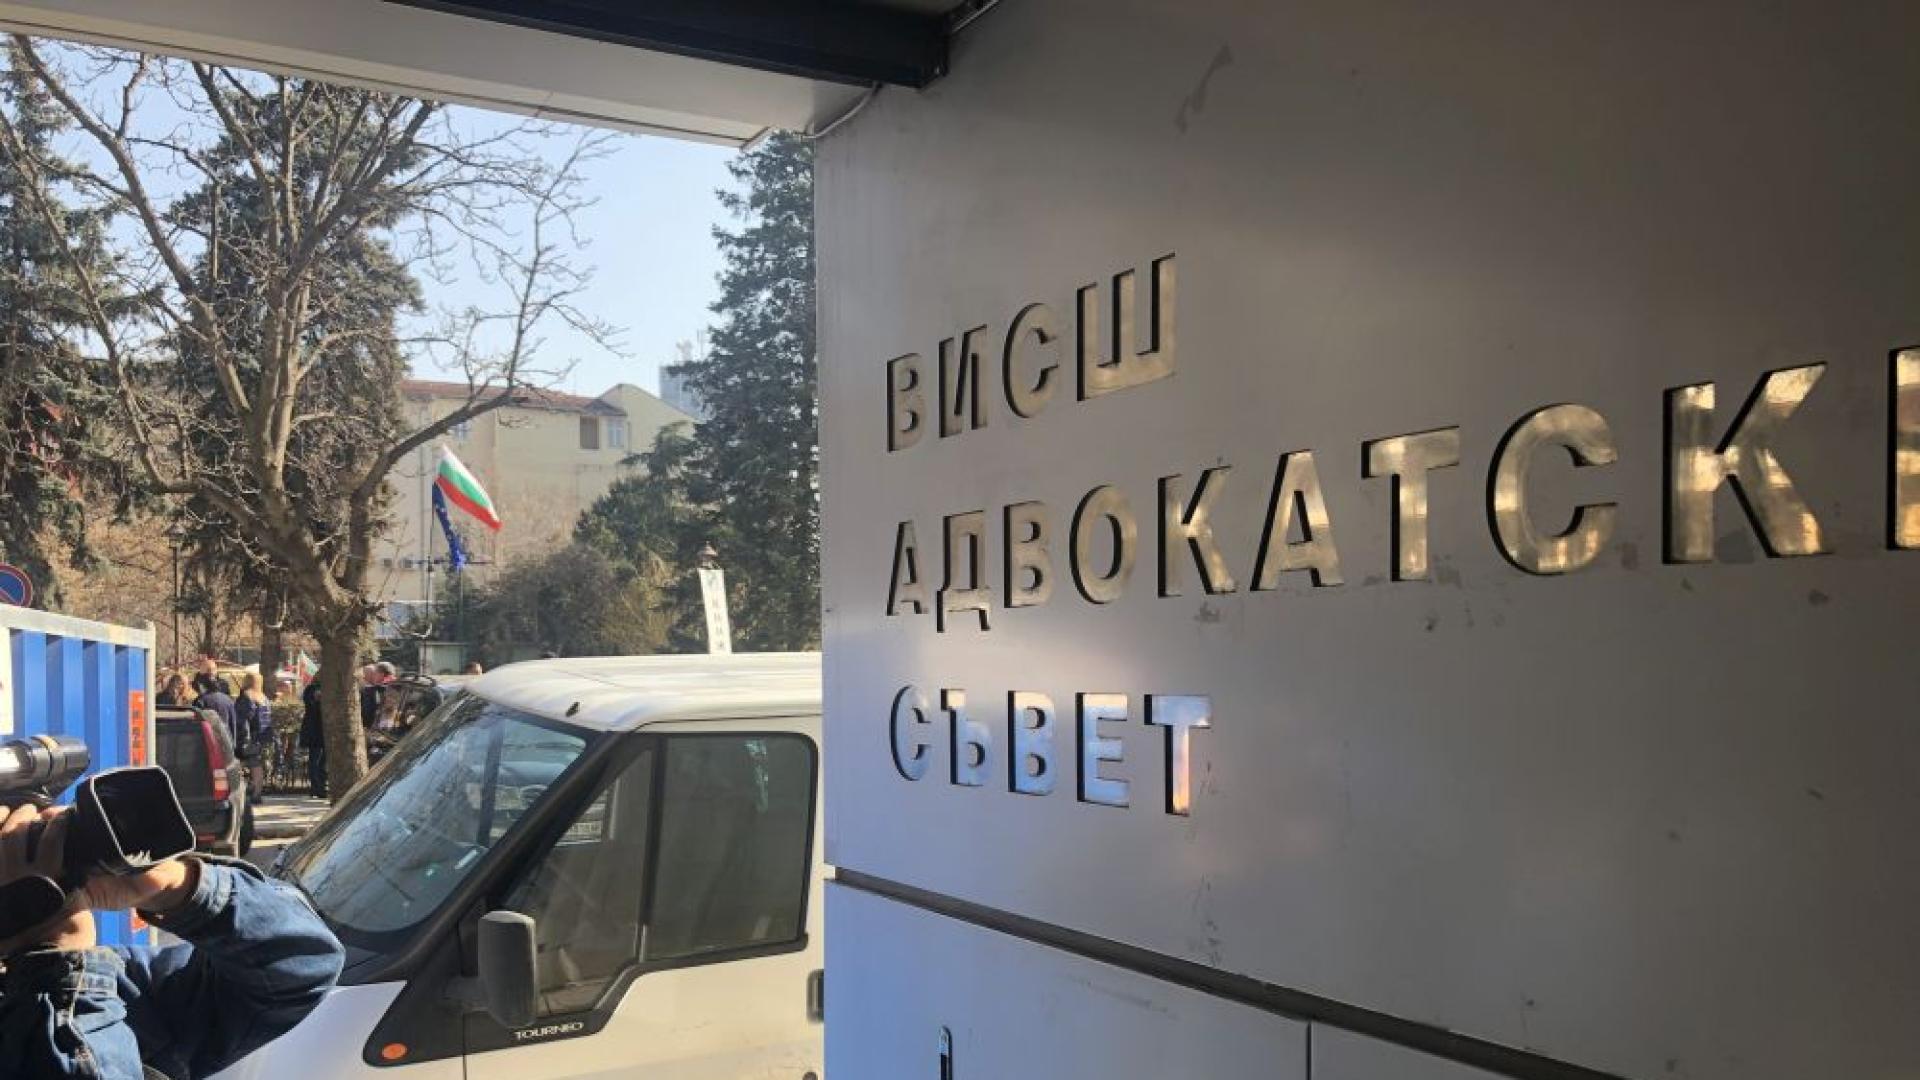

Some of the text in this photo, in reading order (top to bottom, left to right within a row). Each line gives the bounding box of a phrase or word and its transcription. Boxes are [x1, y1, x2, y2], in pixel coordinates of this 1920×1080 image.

[887, 252, 1176, 453] ВИСШ
[889, 684, 1212, 817] СЪВЕТ
[514, 1021, 584, 1041] TOURNEO
